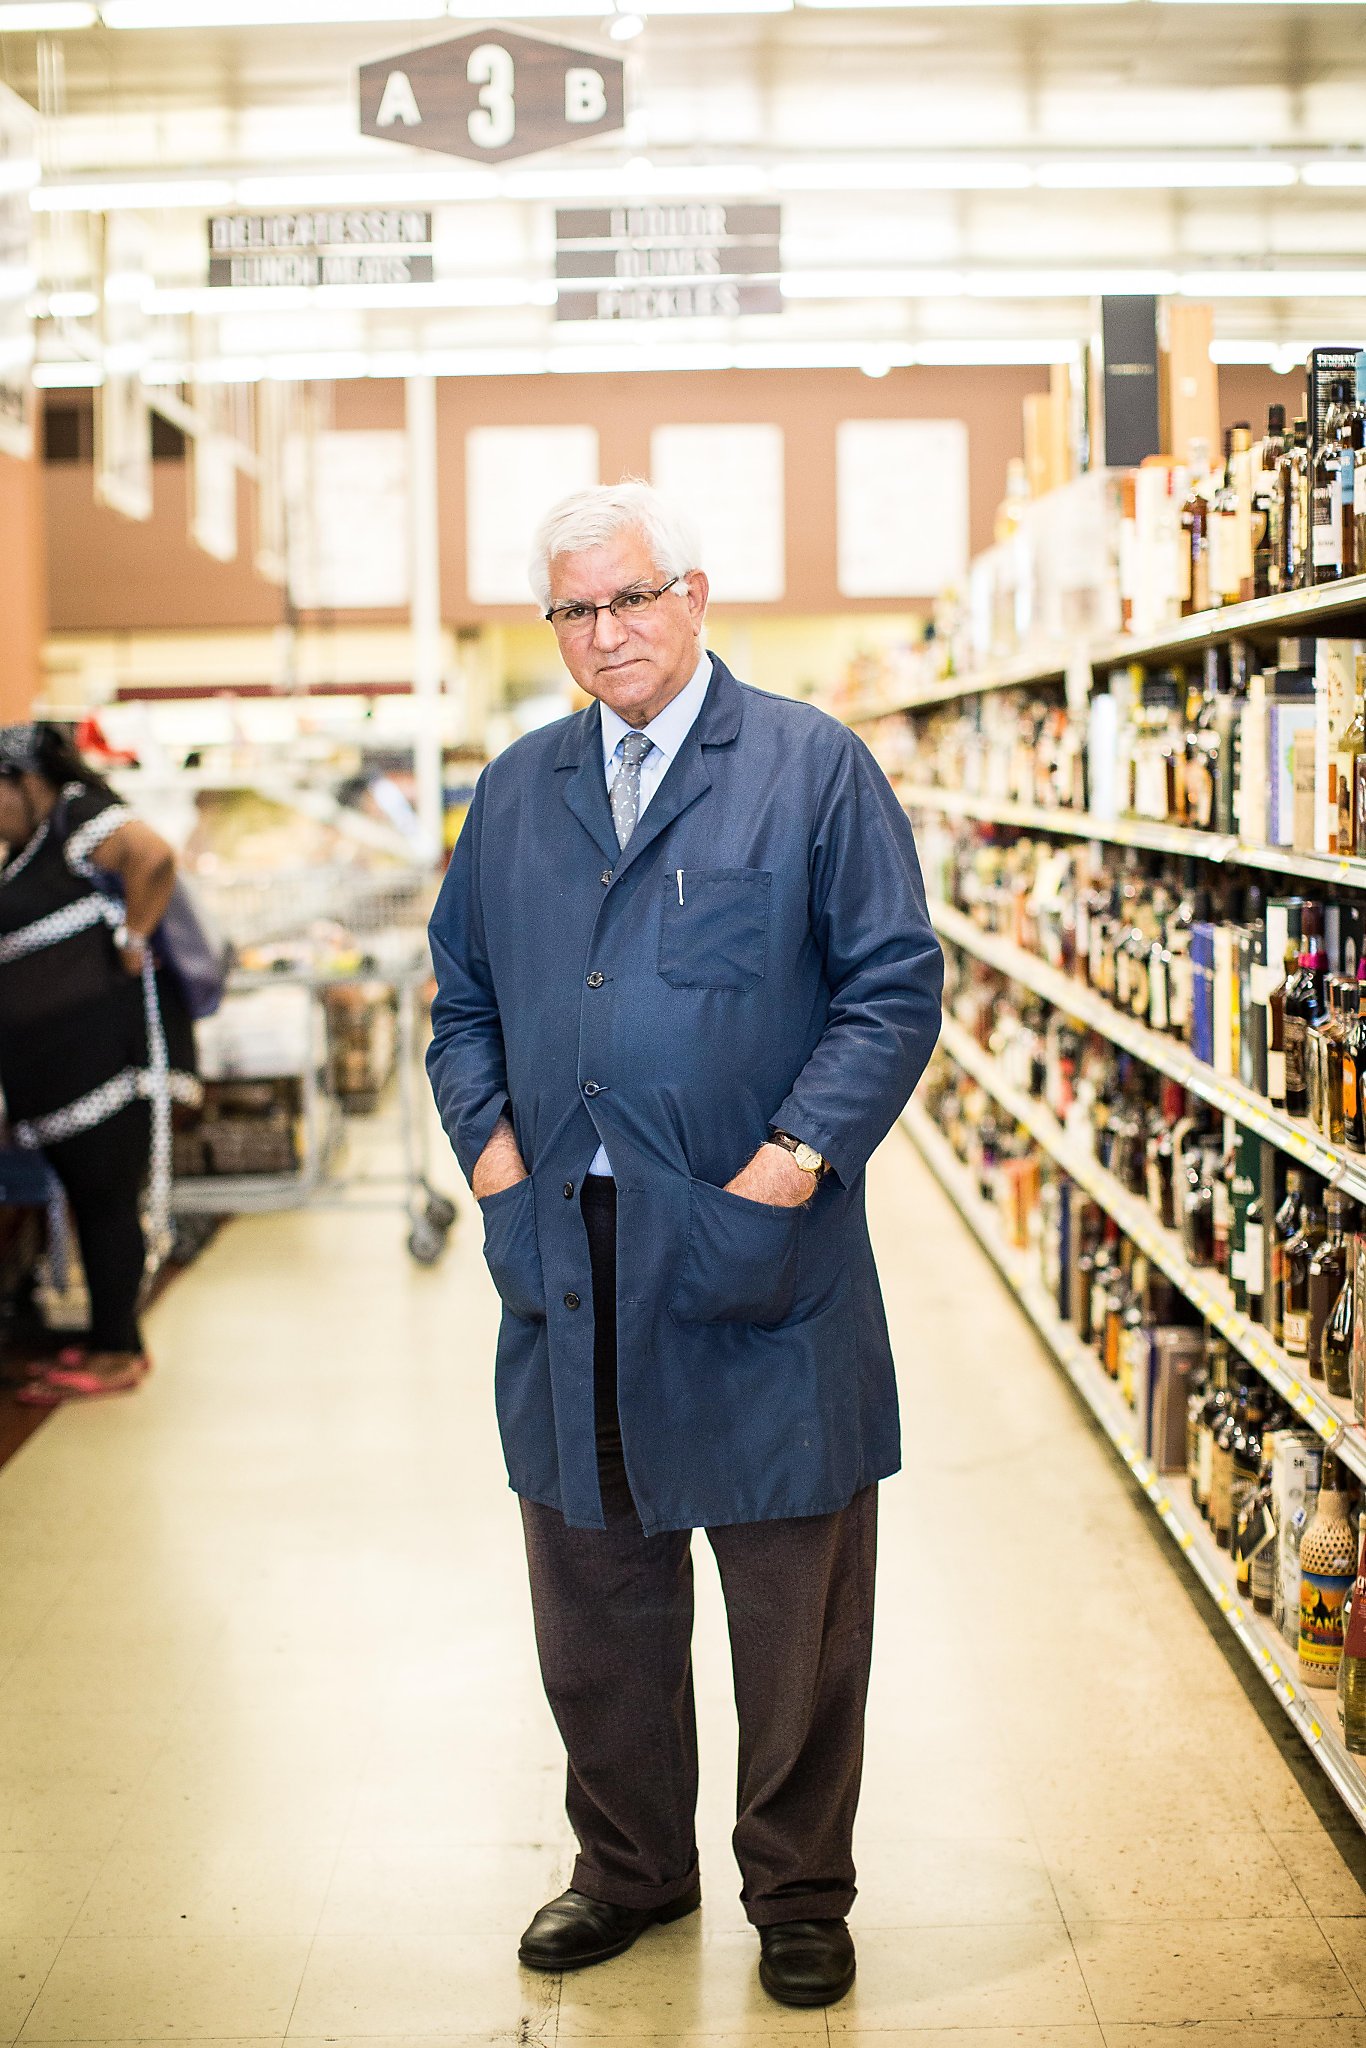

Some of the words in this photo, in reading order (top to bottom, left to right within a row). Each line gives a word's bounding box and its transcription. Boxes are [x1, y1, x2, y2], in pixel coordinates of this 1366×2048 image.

[375, 70, 423, 127] A
[466, 42, 516, 150] 3
[564, 67, 607, 124] B
[212, 209, 426, 248] DELICATESSEN
[231, 254, 318, 286] LUNCH
